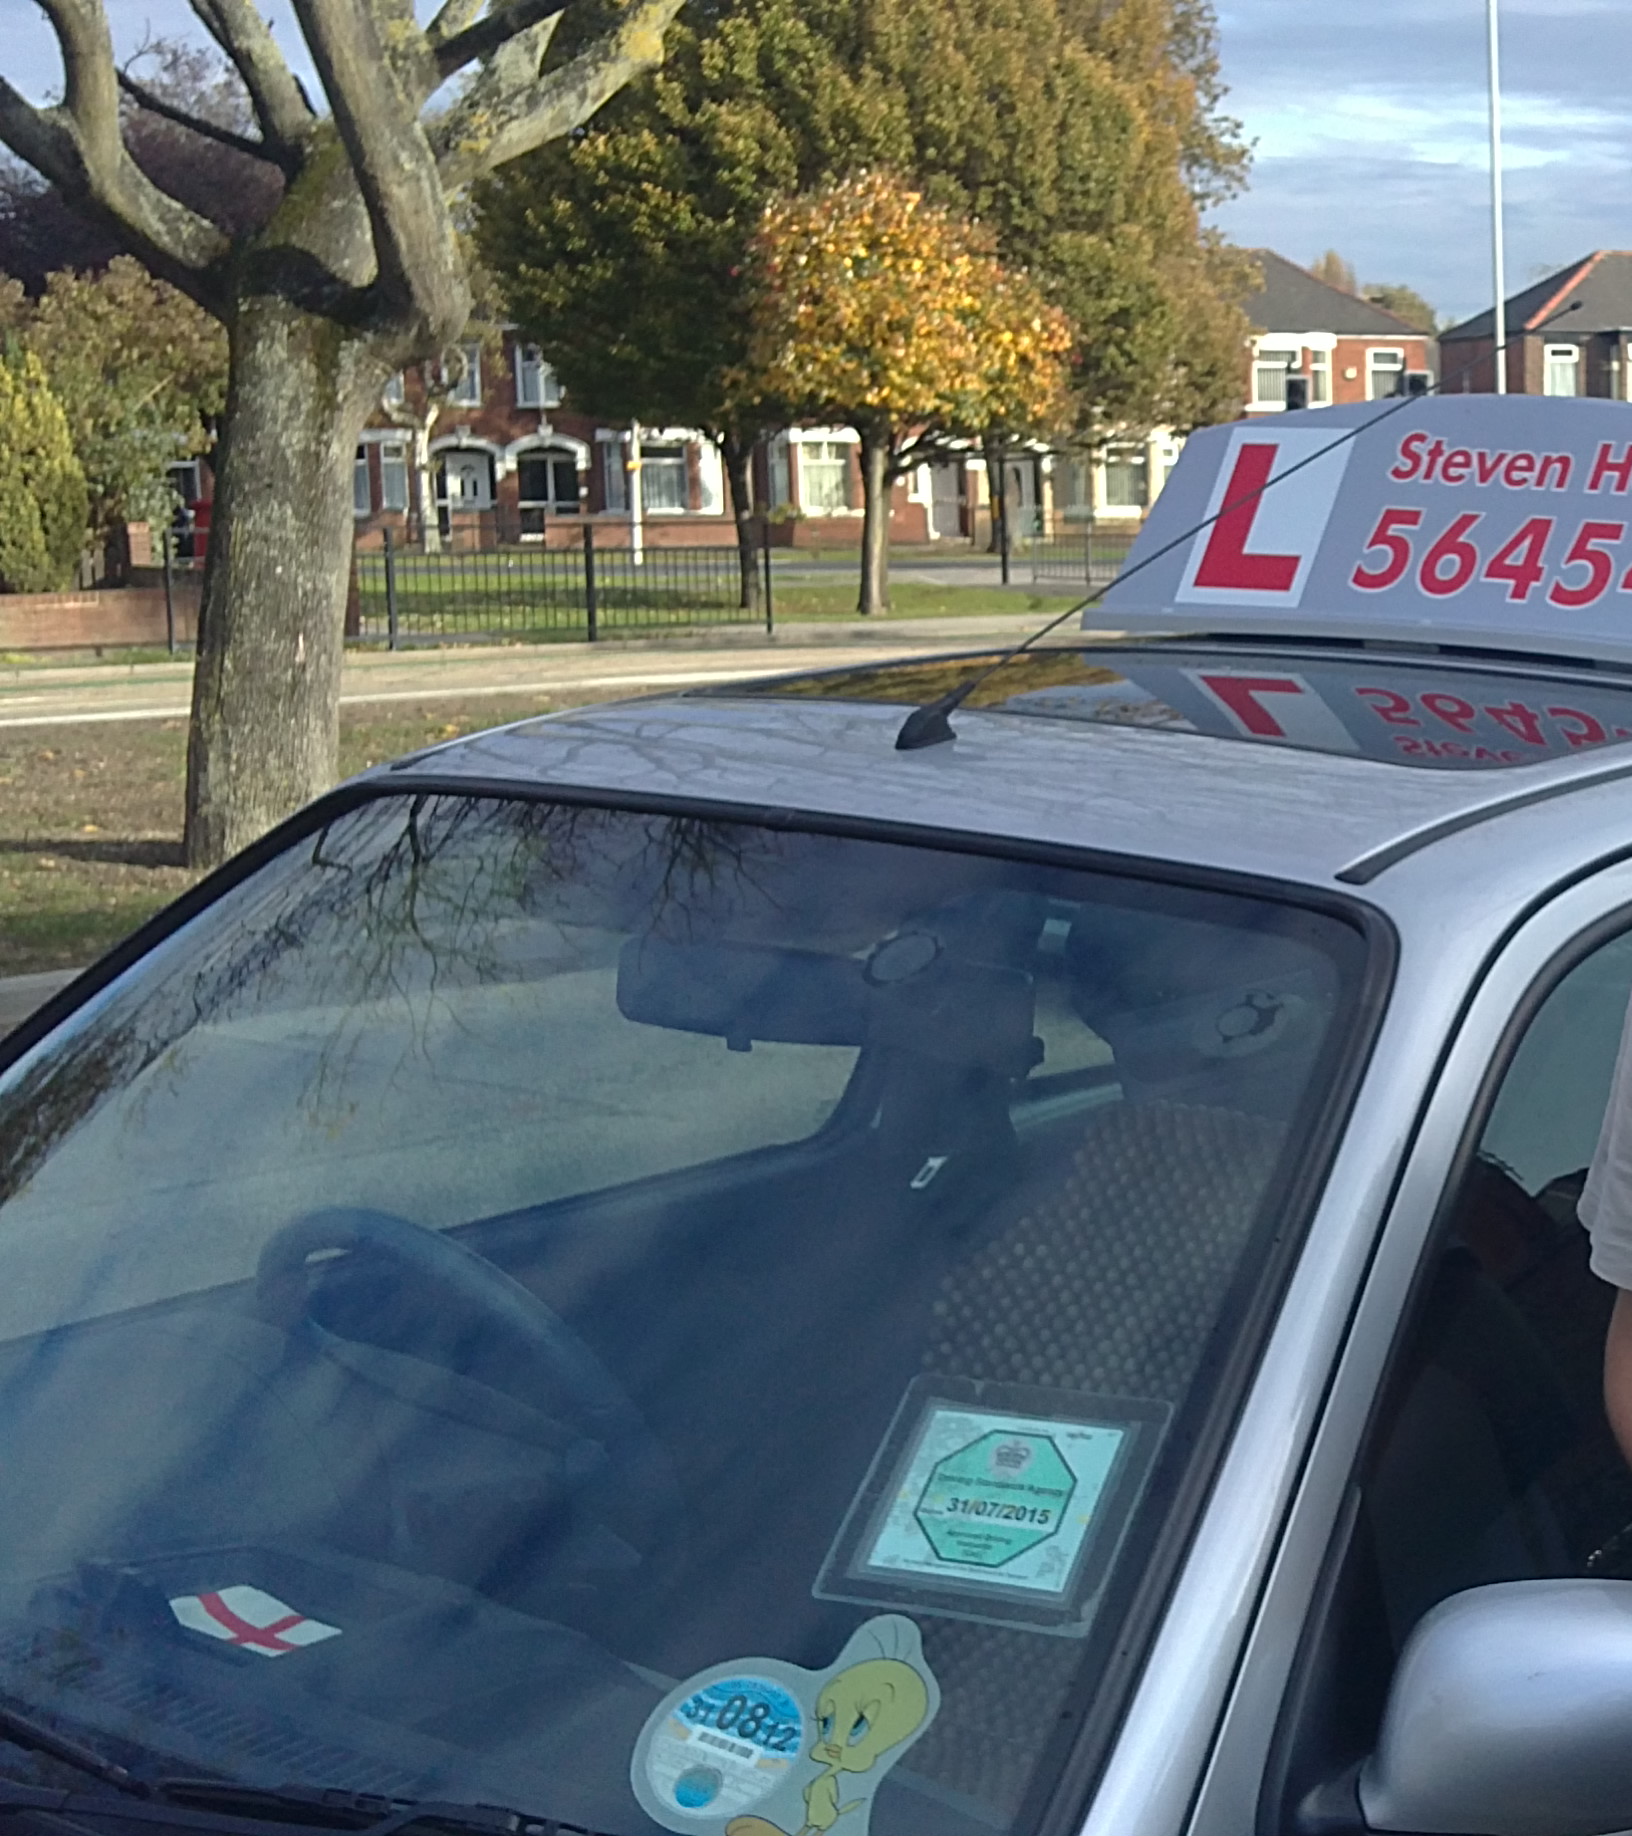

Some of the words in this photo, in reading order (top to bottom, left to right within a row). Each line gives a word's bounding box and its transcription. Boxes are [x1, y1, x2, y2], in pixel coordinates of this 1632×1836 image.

[1389, 431, 1571, 493] Steven
[1192, 442, 1303, 592] L
[946, 1497, 1052, 1525] 31/07/2015
[716, 1694, 771, 1738] 08
